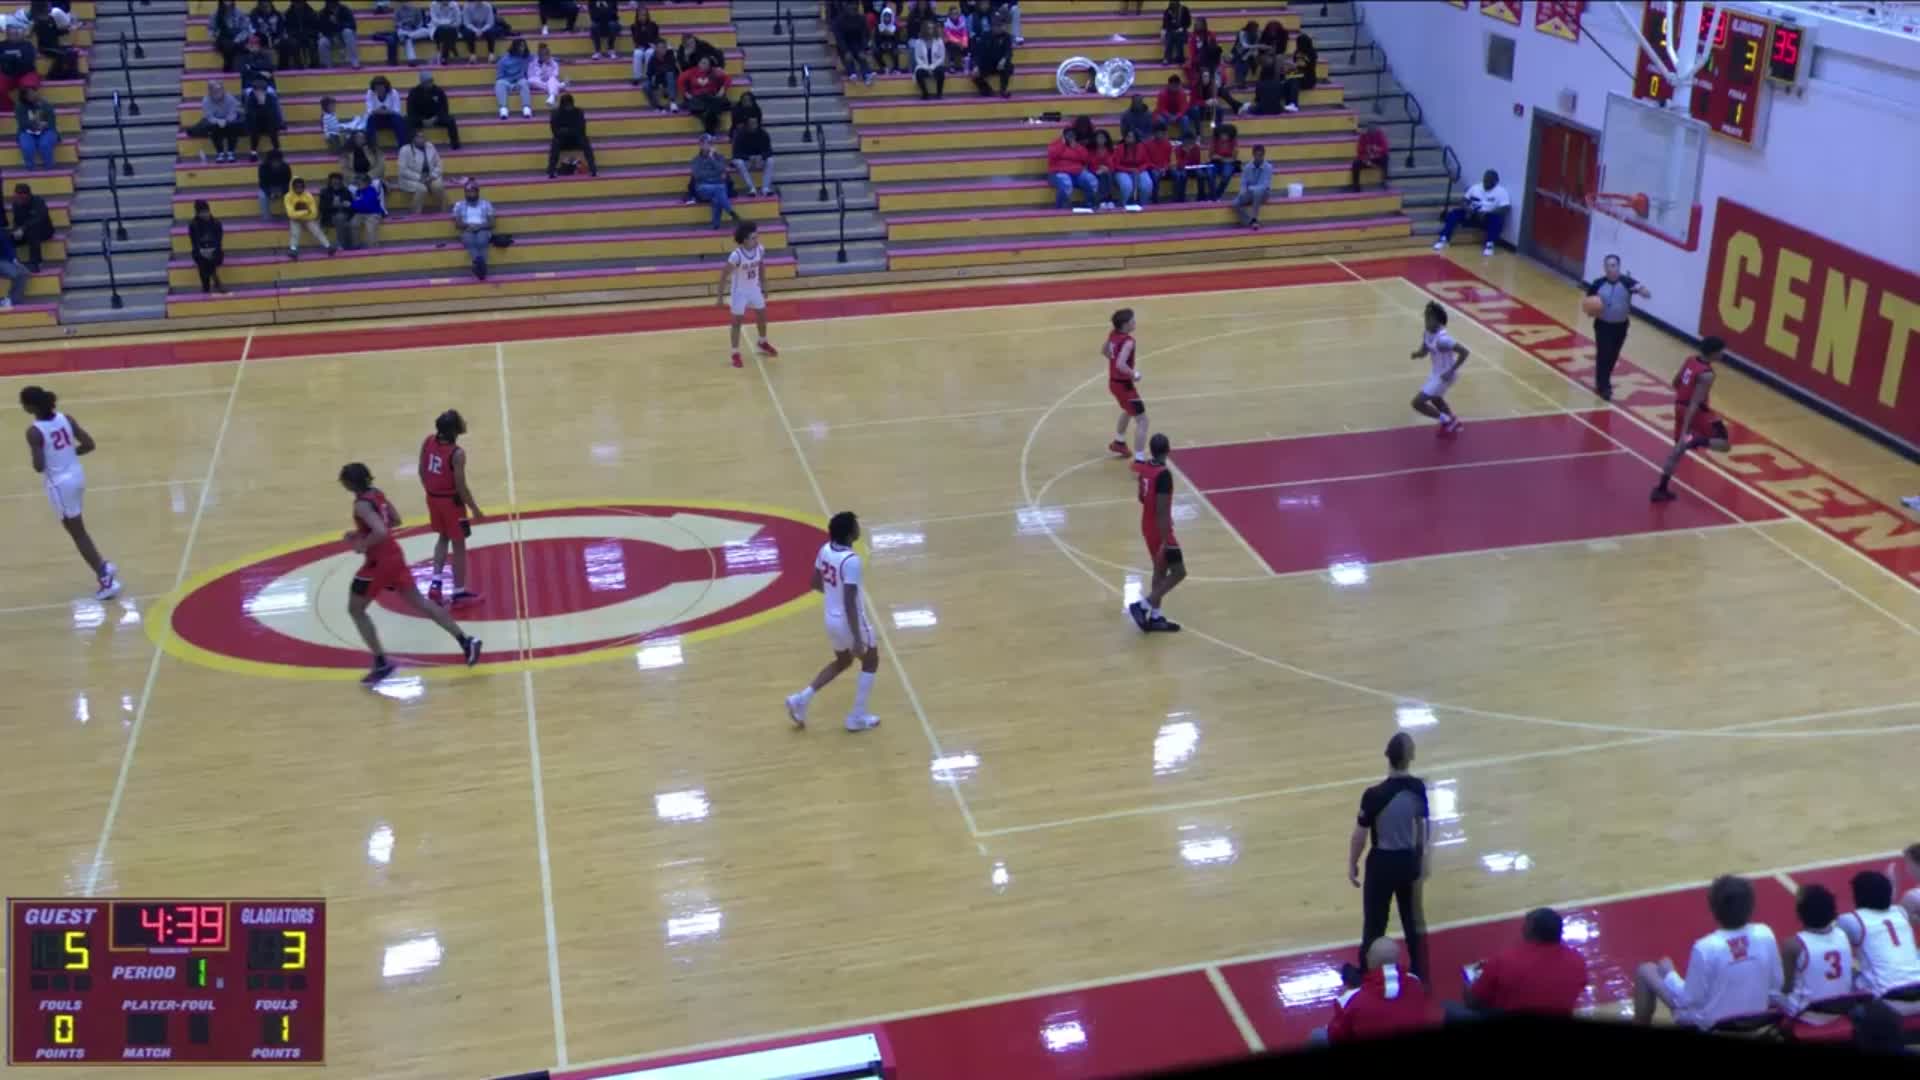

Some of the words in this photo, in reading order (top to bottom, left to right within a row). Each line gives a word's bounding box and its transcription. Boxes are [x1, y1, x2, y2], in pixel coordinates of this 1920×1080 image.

[1743, 41, 1758, 72] 3
[1773, 29, 1798, 64] 35
[1650, 76, 1659, 97] 0
[1718, 230, 1920, 408] CENT
[51, 428, 71, 450] 21
[428, 453, 442, 474] 12
[1705, 443, 1920, 582] CEN
[821, 561, 837, 588] 23
[1883, 919, 1901, 947] 1
[1824, 950, 1842, 979] 3
